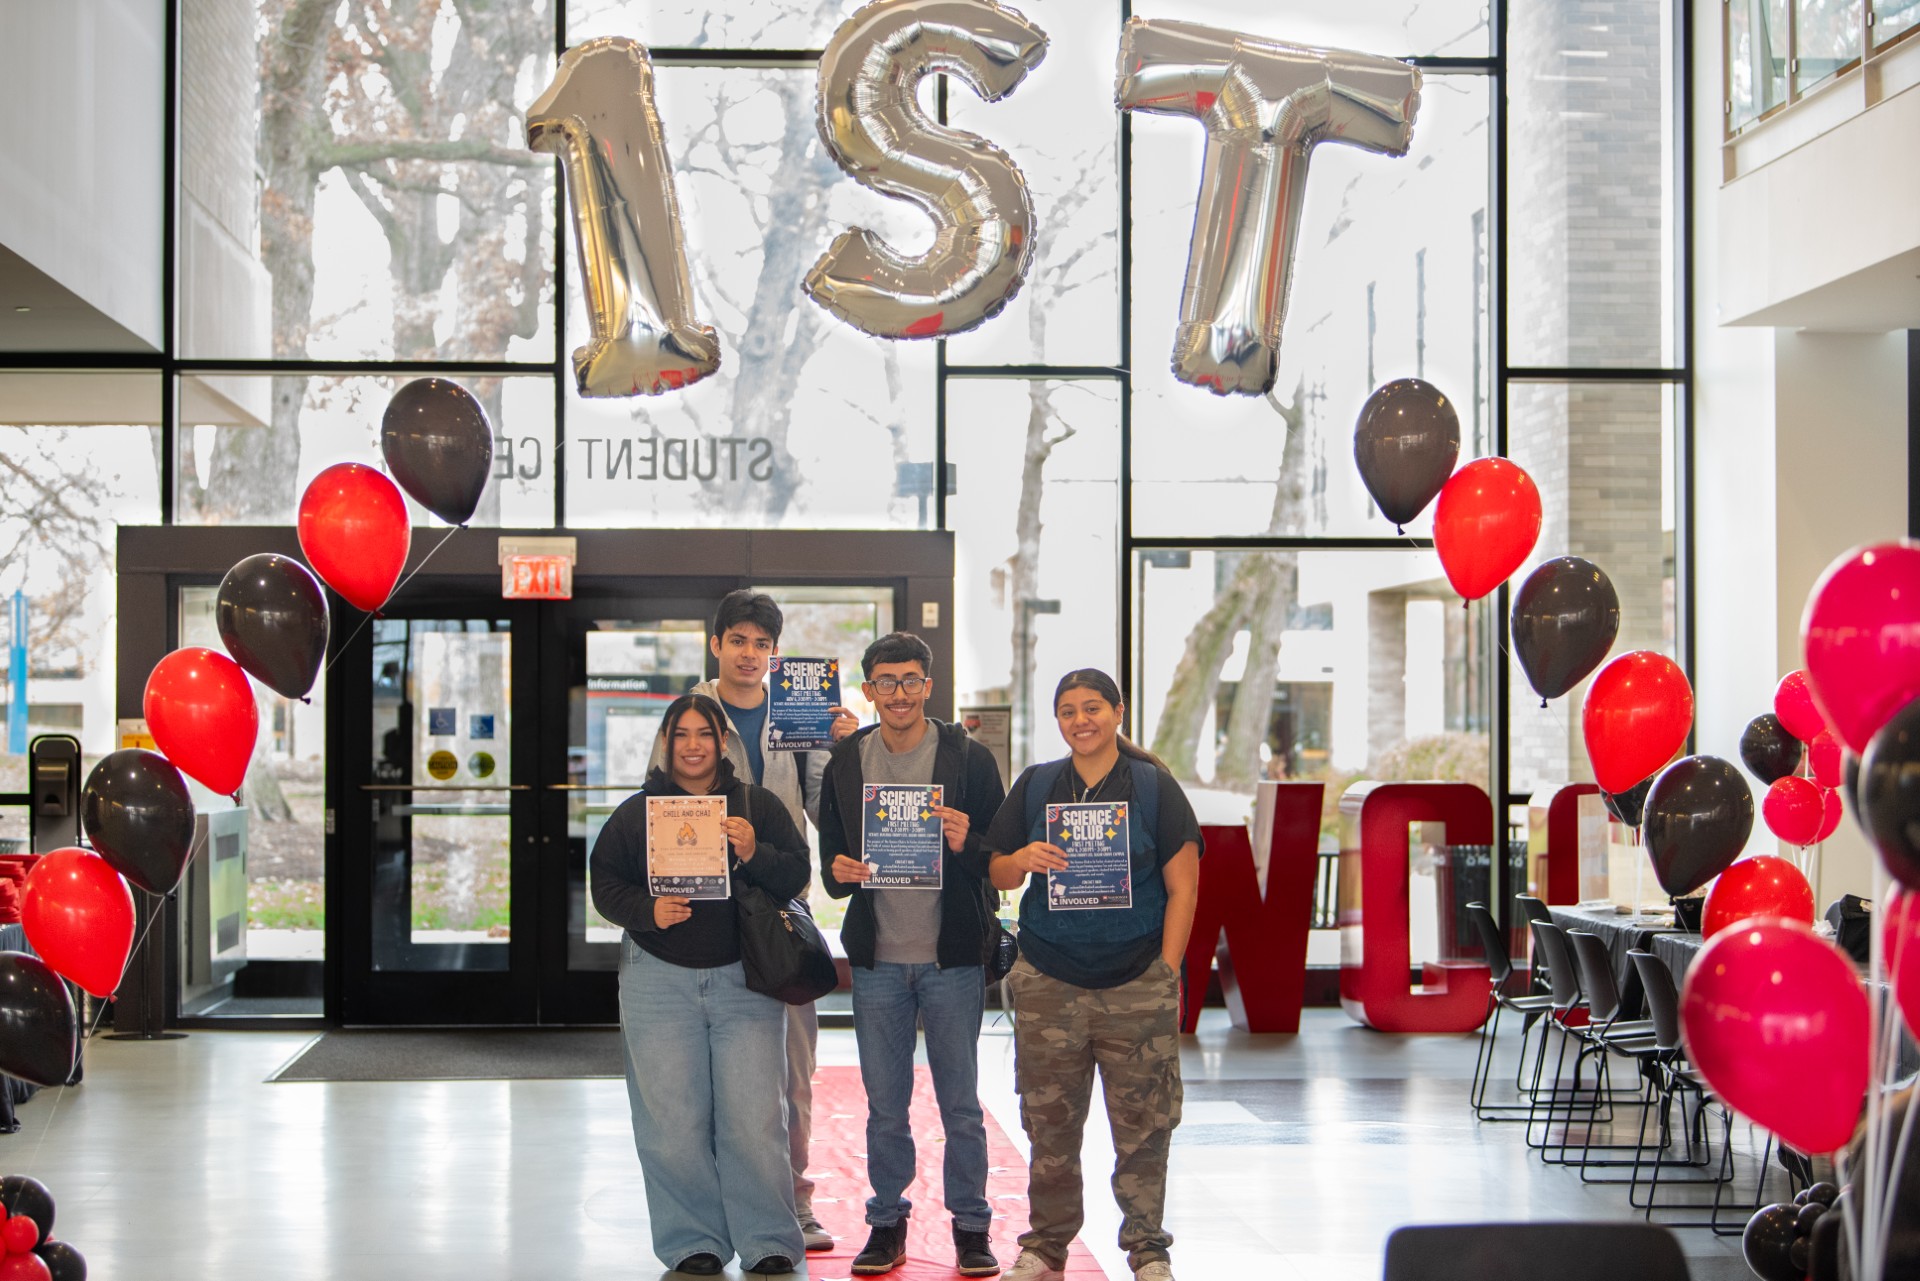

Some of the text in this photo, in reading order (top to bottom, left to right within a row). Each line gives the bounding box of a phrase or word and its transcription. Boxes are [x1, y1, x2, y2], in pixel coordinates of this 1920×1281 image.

[527, 0, 1424, 397] 1ST
[512, 559, 566, 593] EXIT
[783, 662, 826, 677] SCIENCE
[587, 678, 647, 690] Information
[793, 677, 820, 690] CLUB
[879, 791, 927, 806] SCIENCE
[663, 810, 680, 818] CHILL
[696, 809, 711, 817] CHAI
[889, 806, 919, 821] CLUB
[1062, 810, 1112, 826] SCIENCE
[1073, 825, 1103, 840] CLUB
[661, 886, 695, 894] INVOLVED
[1059, 897, 1099, 905] INVOLVED
